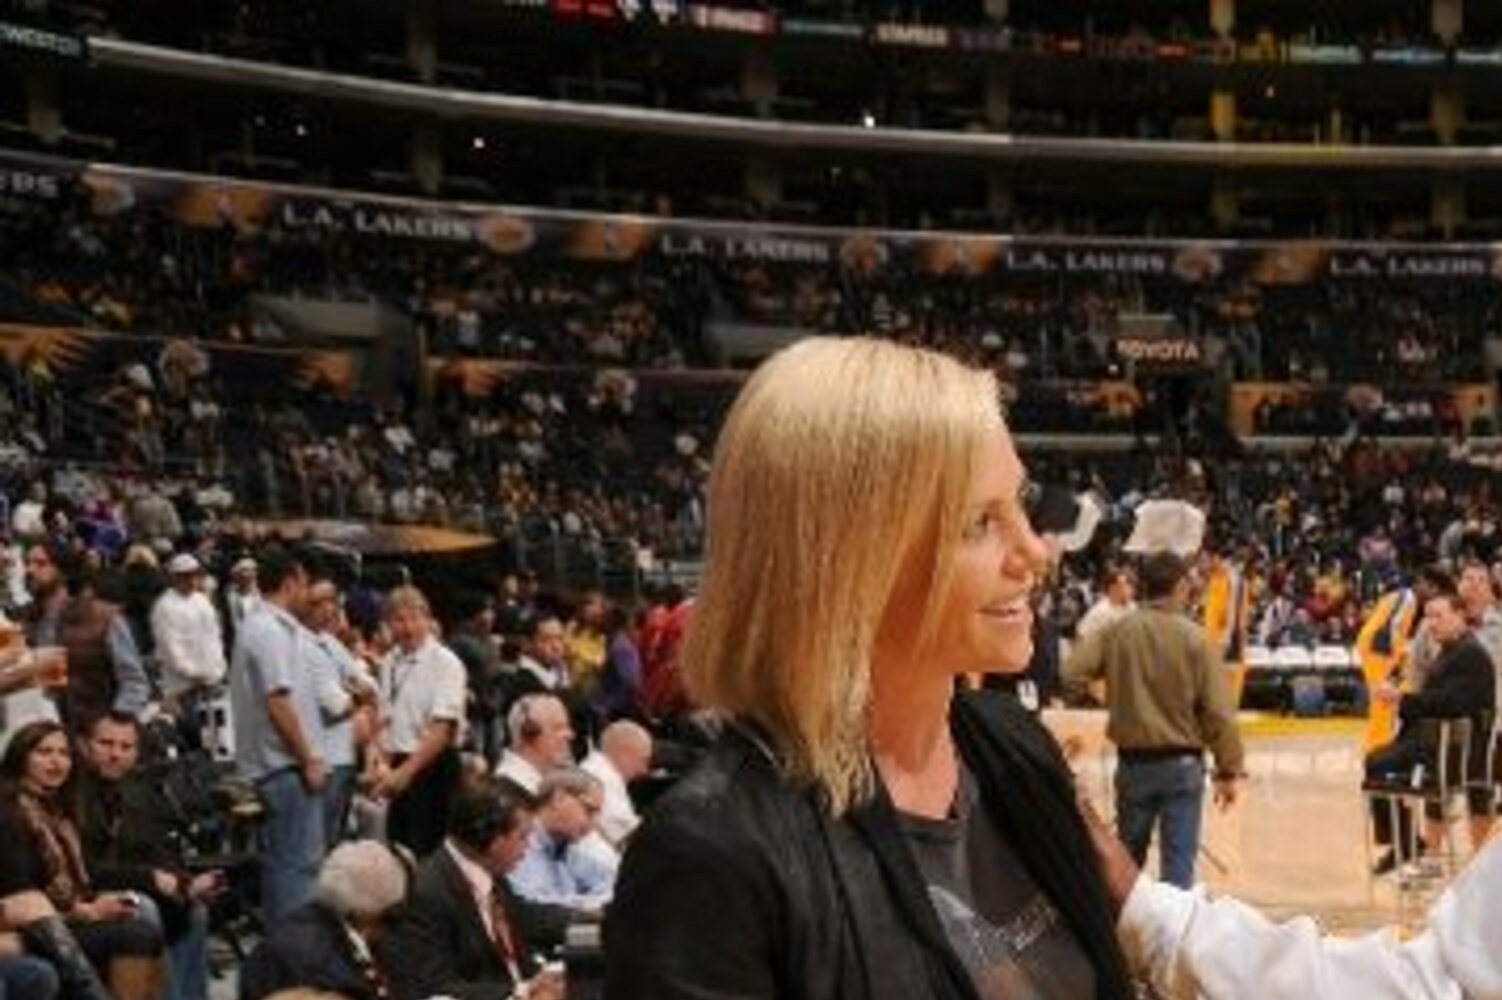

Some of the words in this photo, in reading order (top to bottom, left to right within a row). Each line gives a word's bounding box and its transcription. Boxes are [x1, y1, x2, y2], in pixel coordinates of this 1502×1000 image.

[284, 202, 346, 229] L.A.
[355, 209, 473, 241] LAKERS
[1007, 252, 1056, 272] L.A.
[1065, 253, 1166, 273] LAKERS
[1331, 257, 1375, 276] L.A.
[1387, 258, 1486, 277] LAKERS
